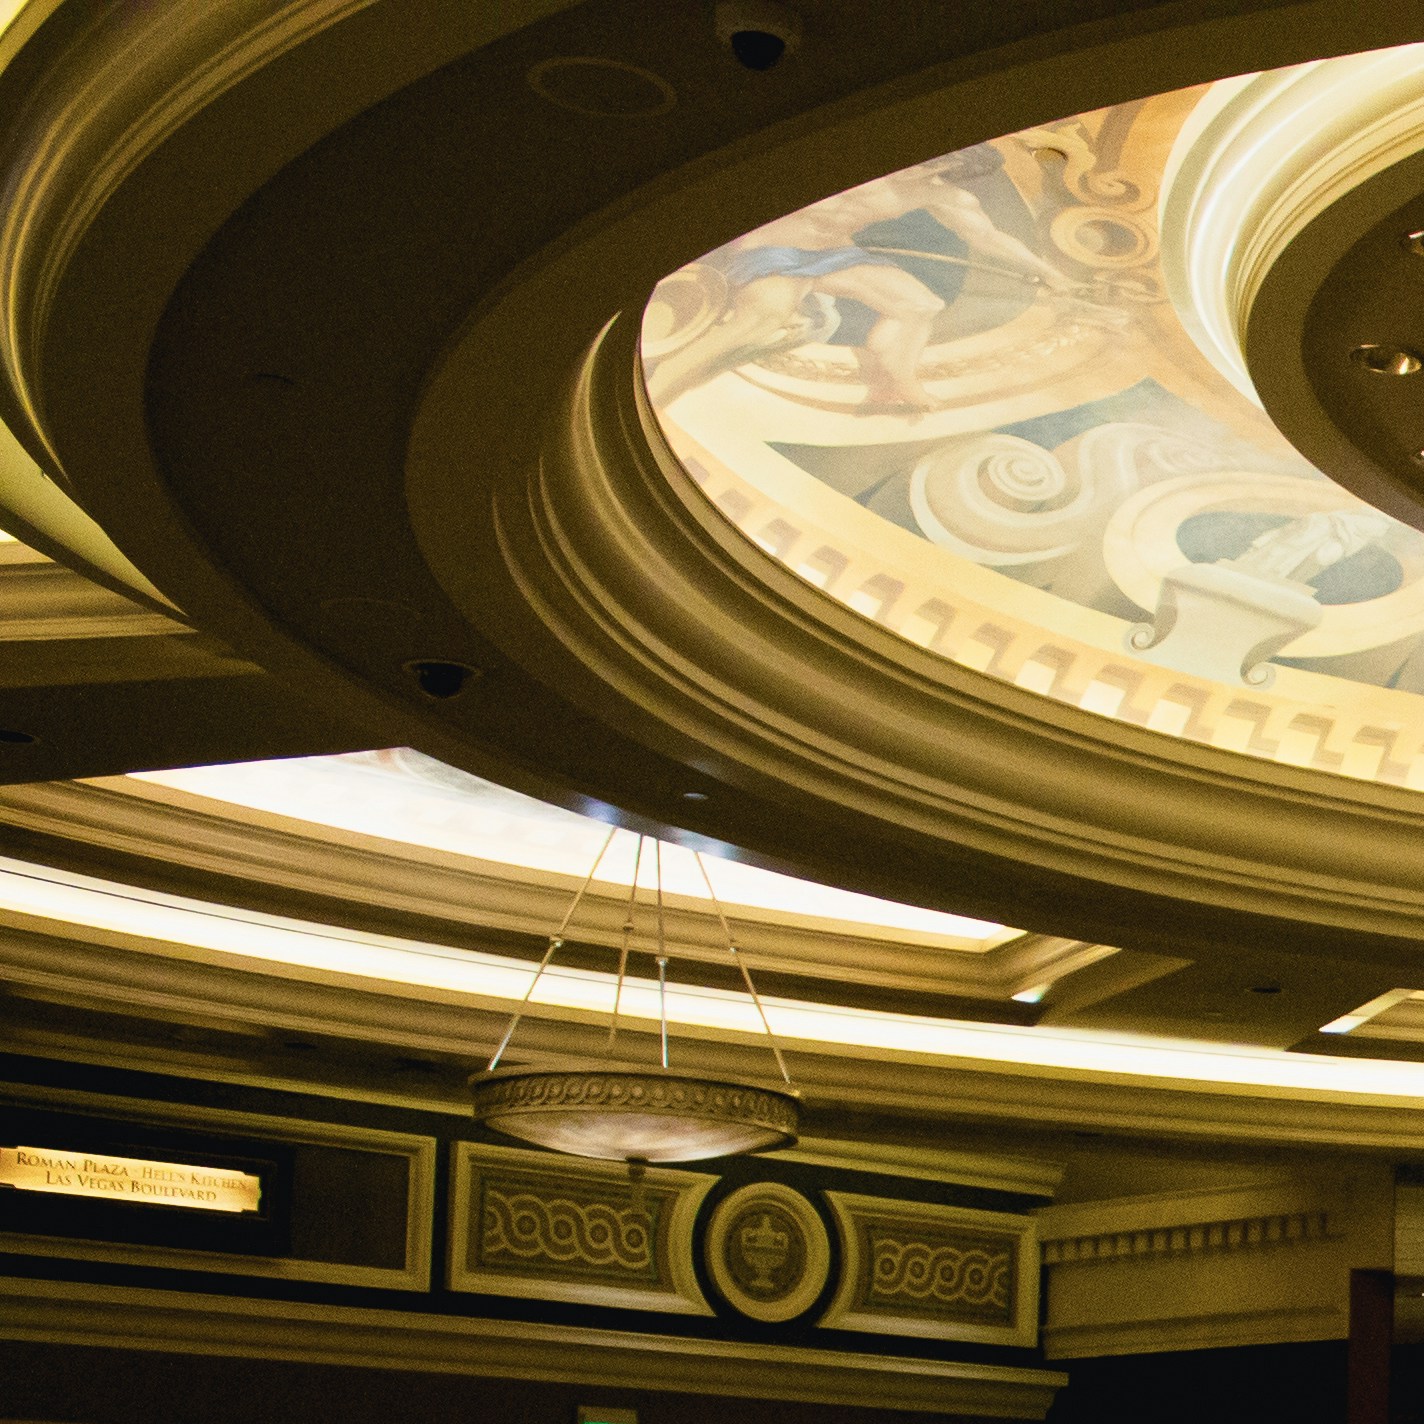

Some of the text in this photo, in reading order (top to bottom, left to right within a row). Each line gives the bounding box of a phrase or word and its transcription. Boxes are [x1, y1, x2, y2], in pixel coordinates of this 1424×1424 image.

[17, 1152, 76, 1170] ROMAN
[84, 1159, 129, 1177] PLAZA
[191, 1172, 248, 1190] KITCHEN
[46, 1170, 217, 1201] LAS VEGAS BOULEVARD
